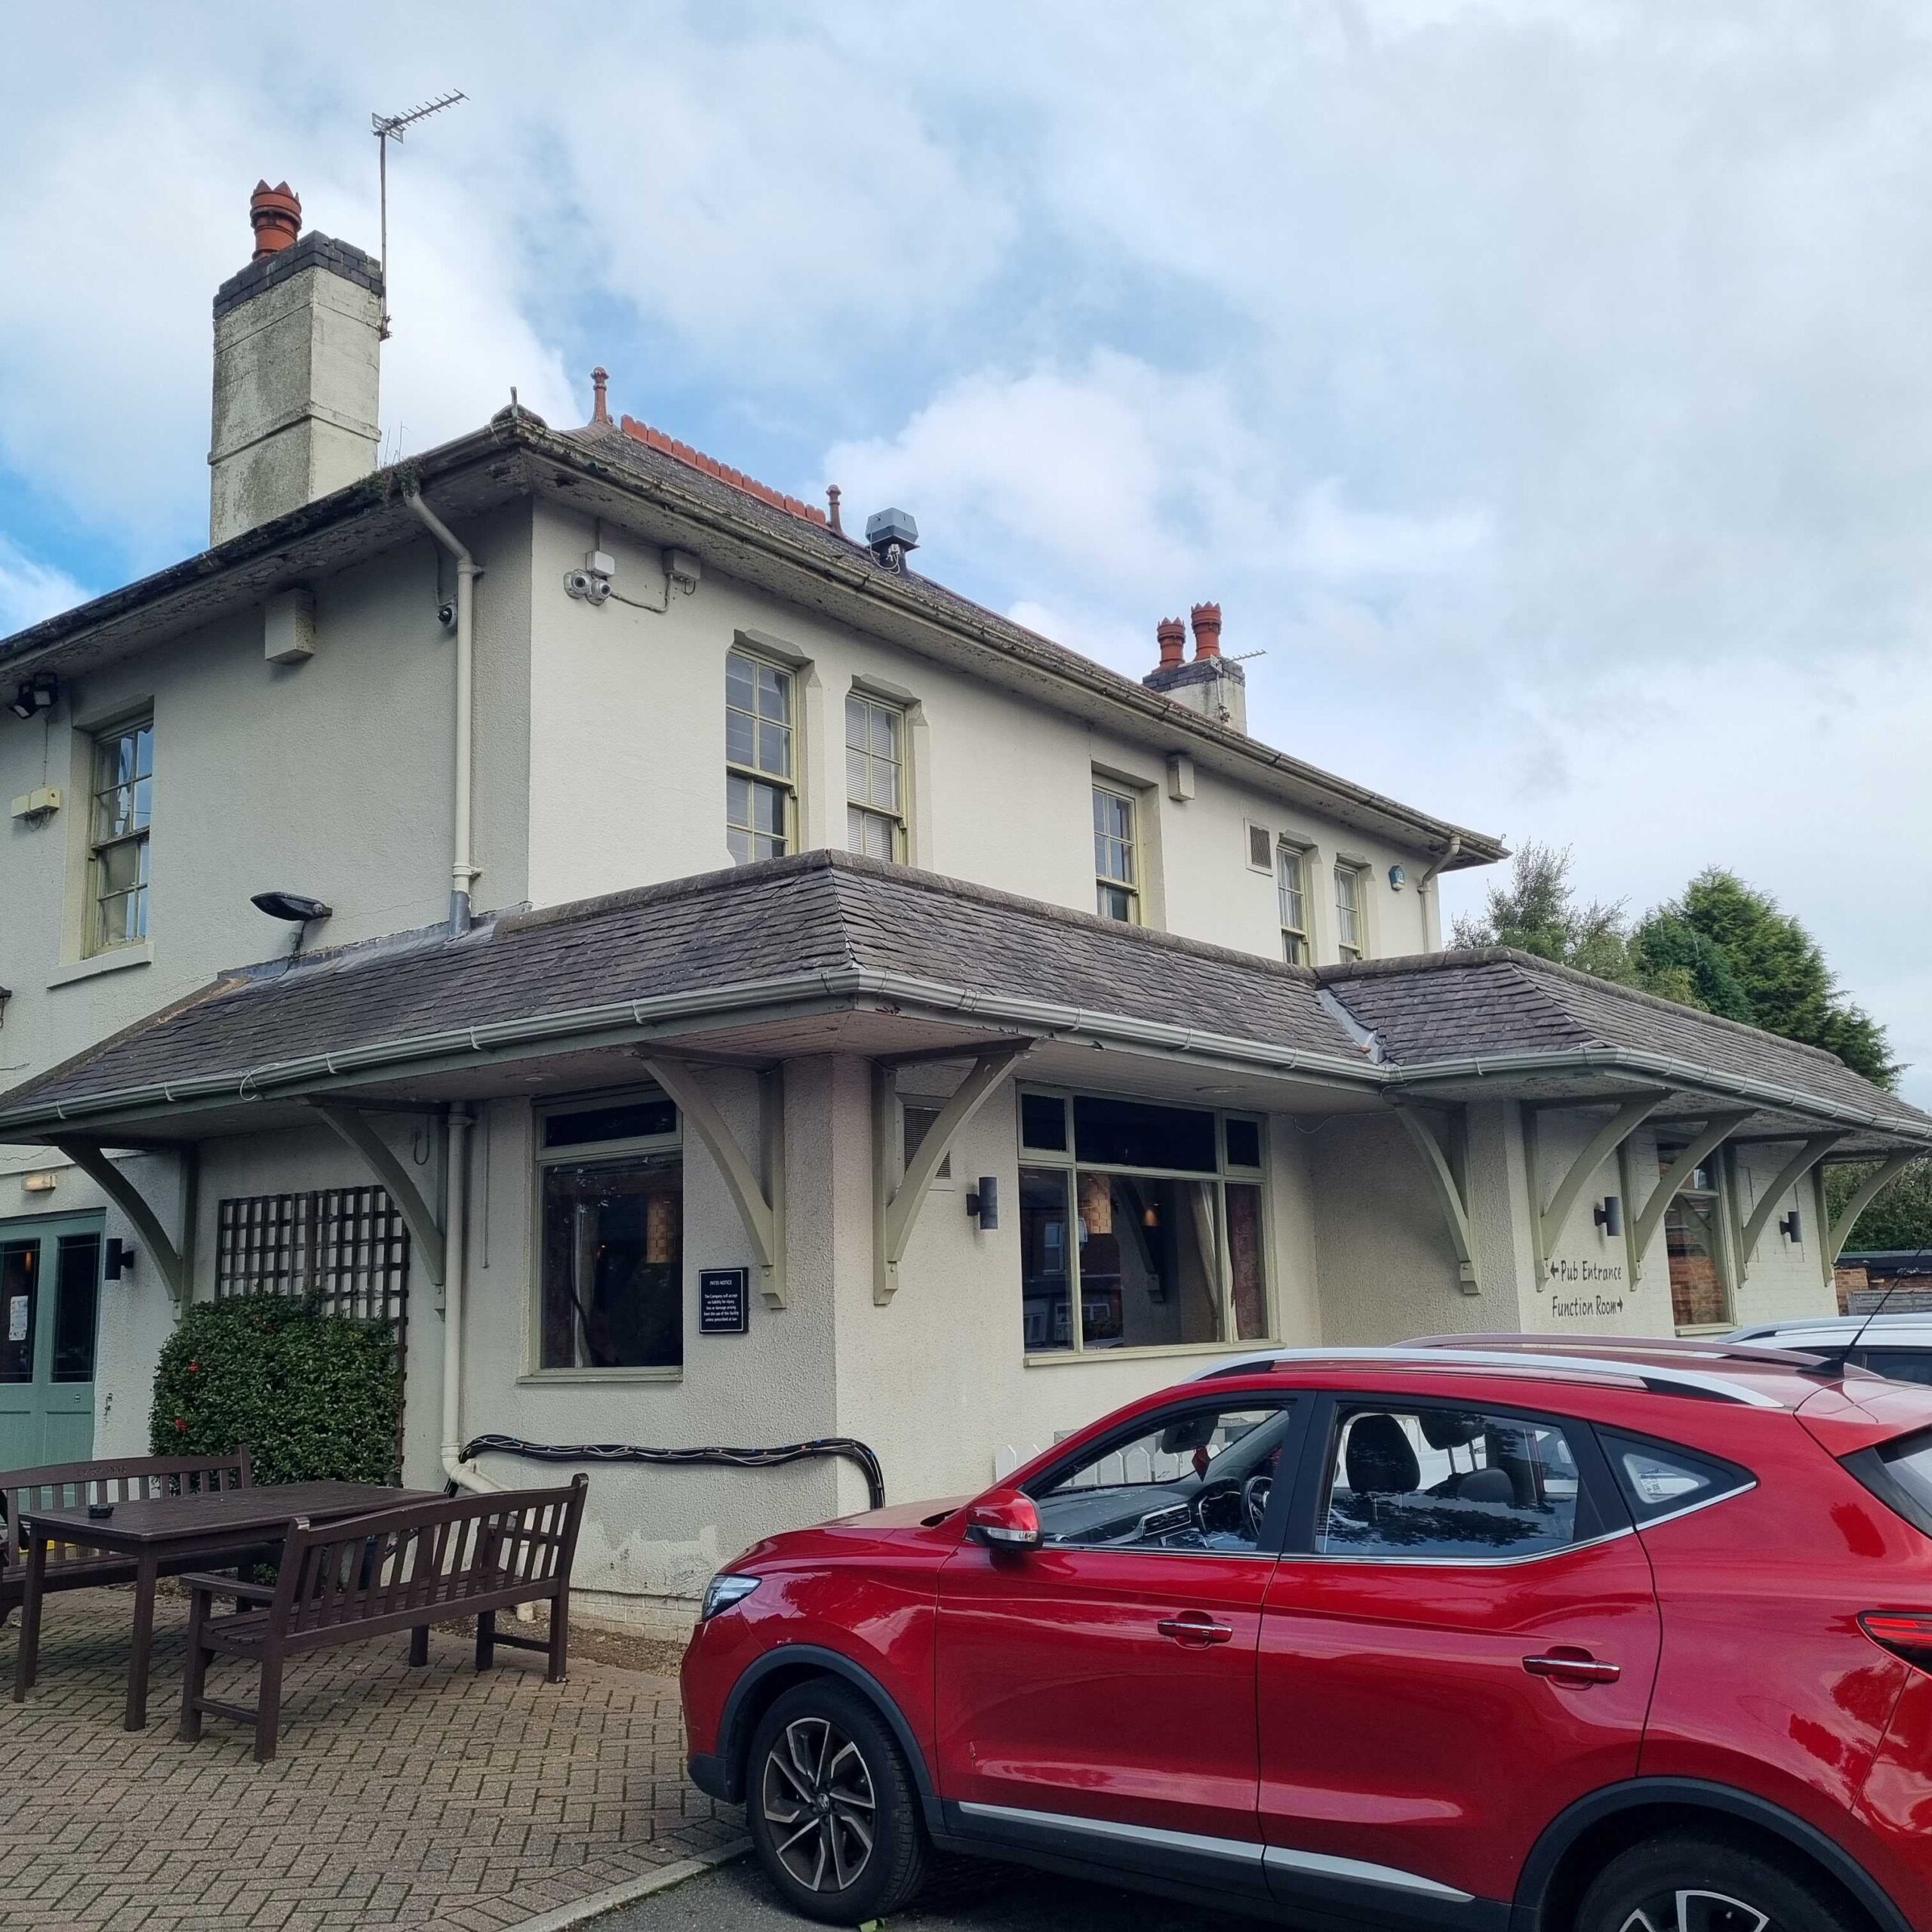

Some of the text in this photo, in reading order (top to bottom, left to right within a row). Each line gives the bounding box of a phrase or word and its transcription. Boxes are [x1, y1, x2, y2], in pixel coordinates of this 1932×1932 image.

[1561, 1260, 1622, 1281] Pub Entrance
[1552, 1295, 1617, 1317] Function Room
